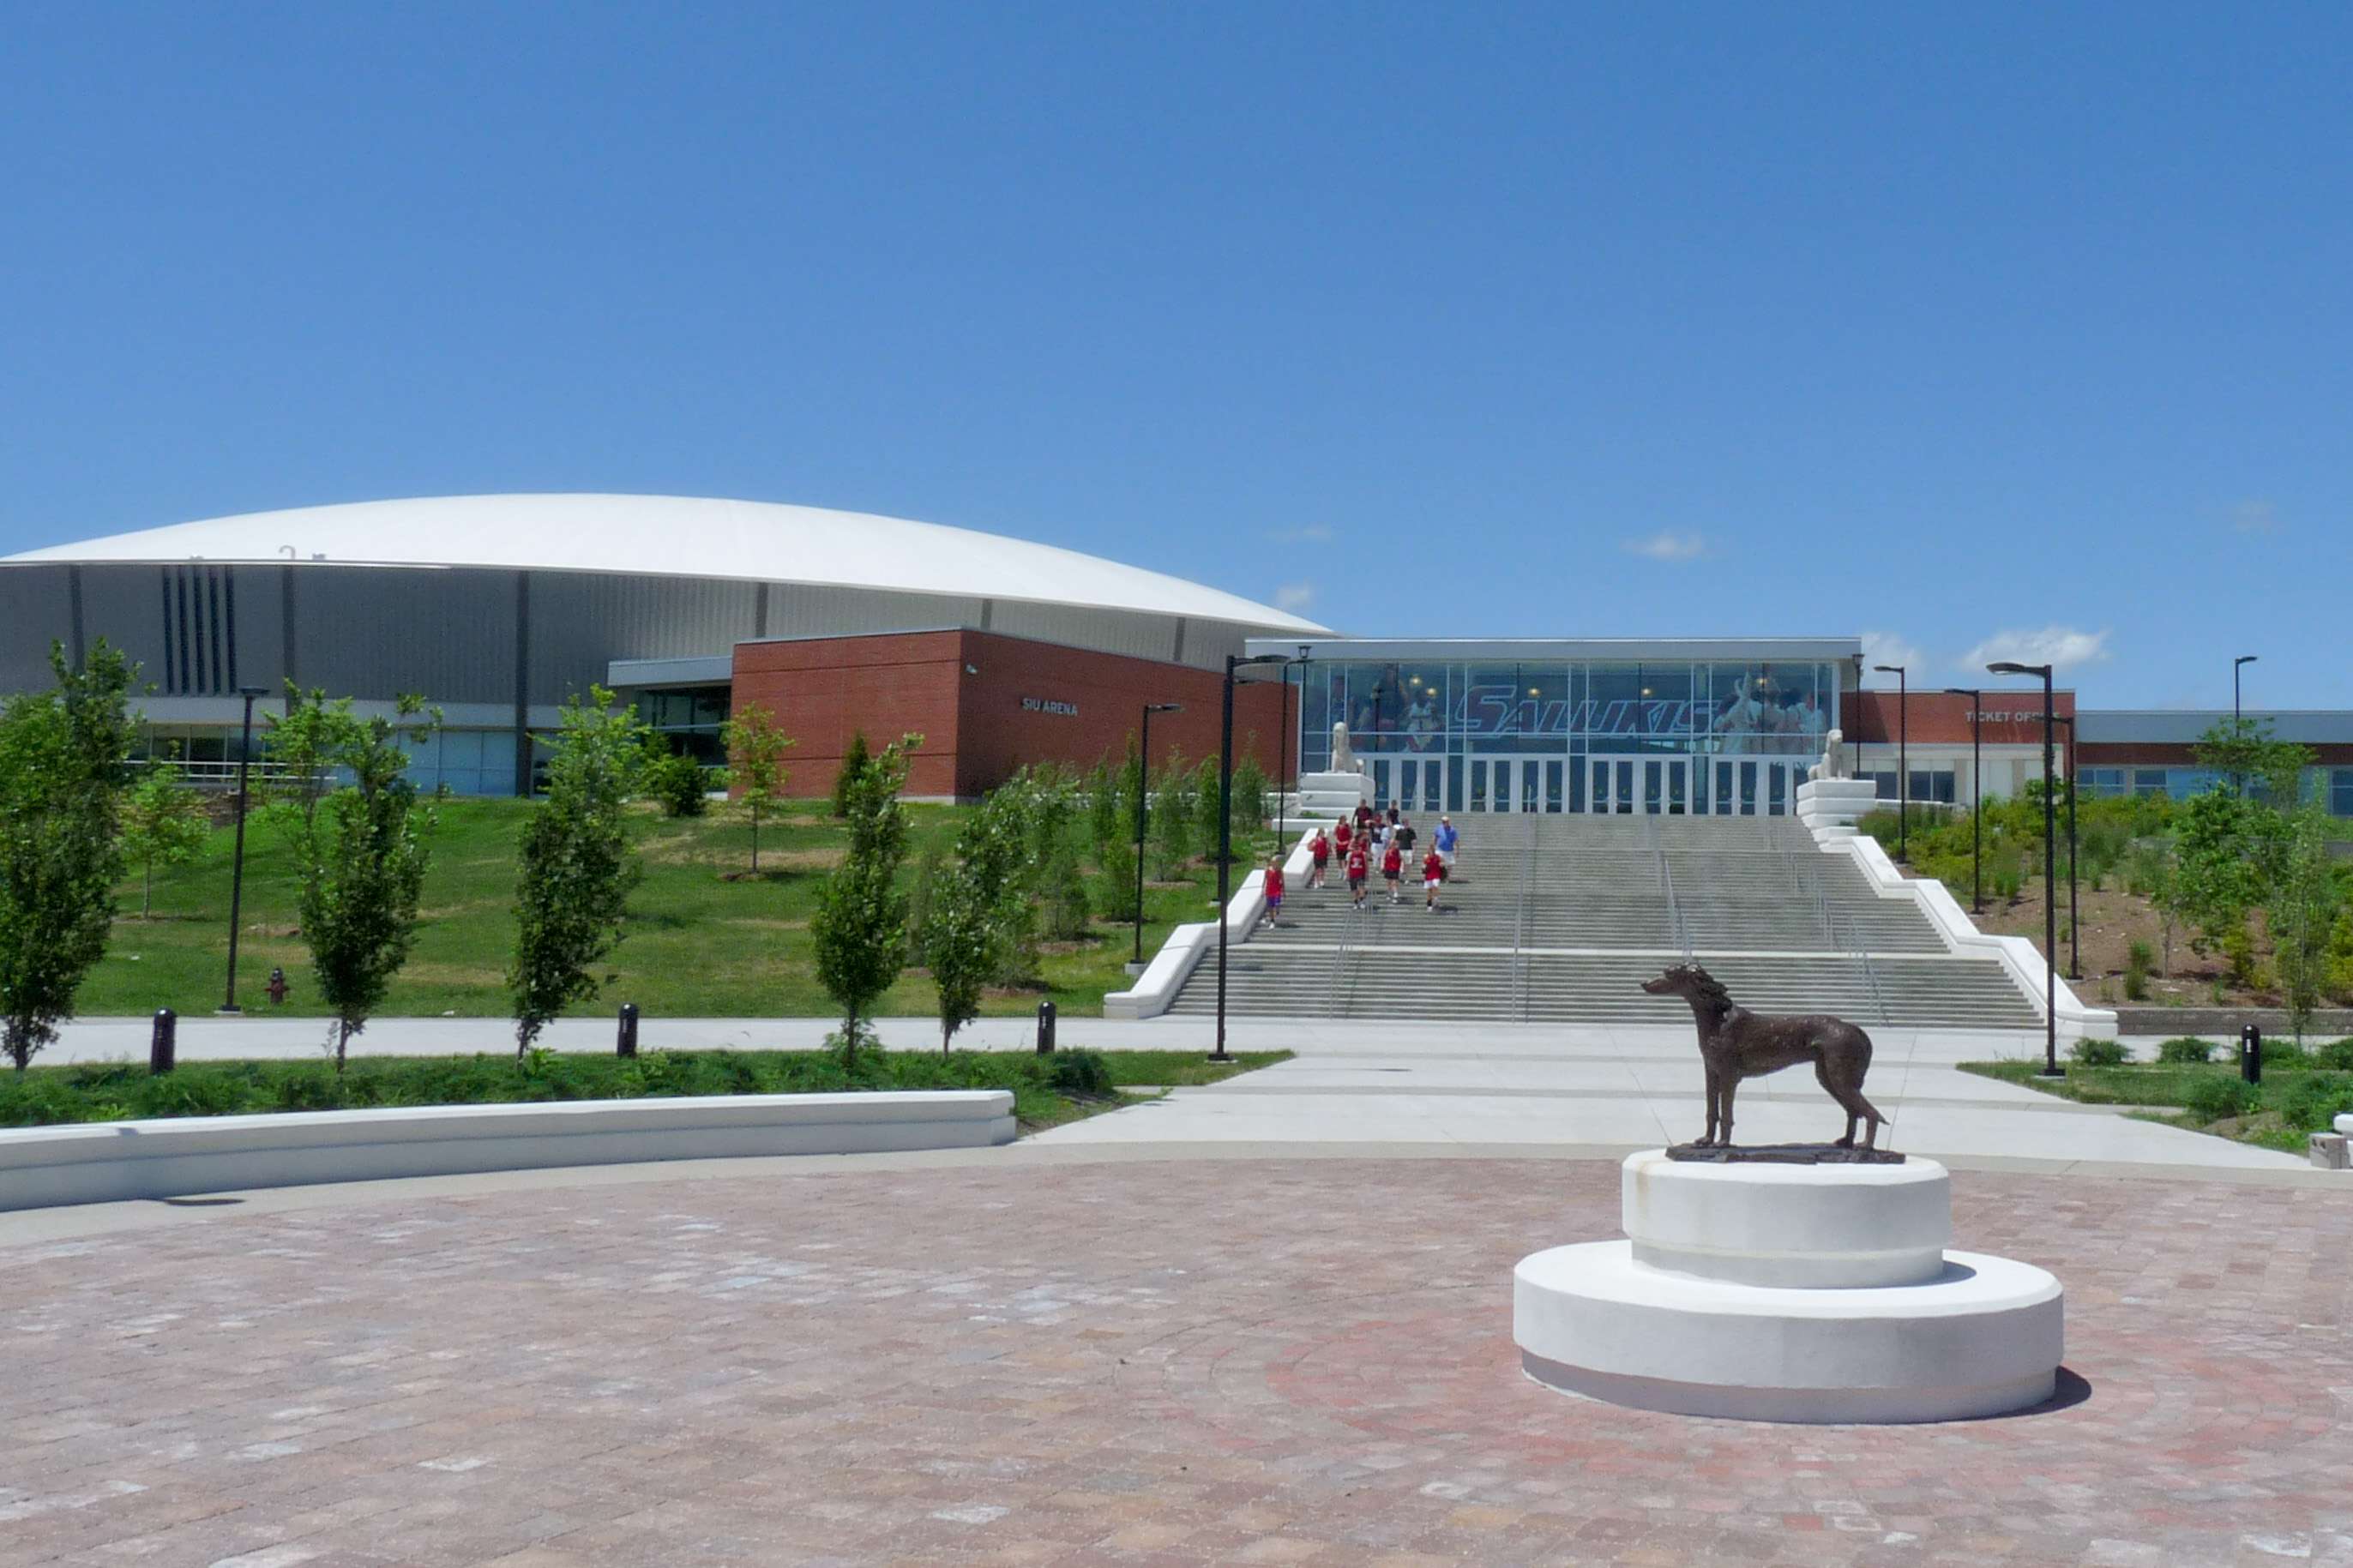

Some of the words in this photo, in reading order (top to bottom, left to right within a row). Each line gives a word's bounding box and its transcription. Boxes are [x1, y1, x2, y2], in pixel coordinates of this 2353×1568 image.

[1022, 697, 1041, 712] SIU
[1043, 700, 1078, 717] ARENA
[1965, 711, 2011, 723] TICKET
